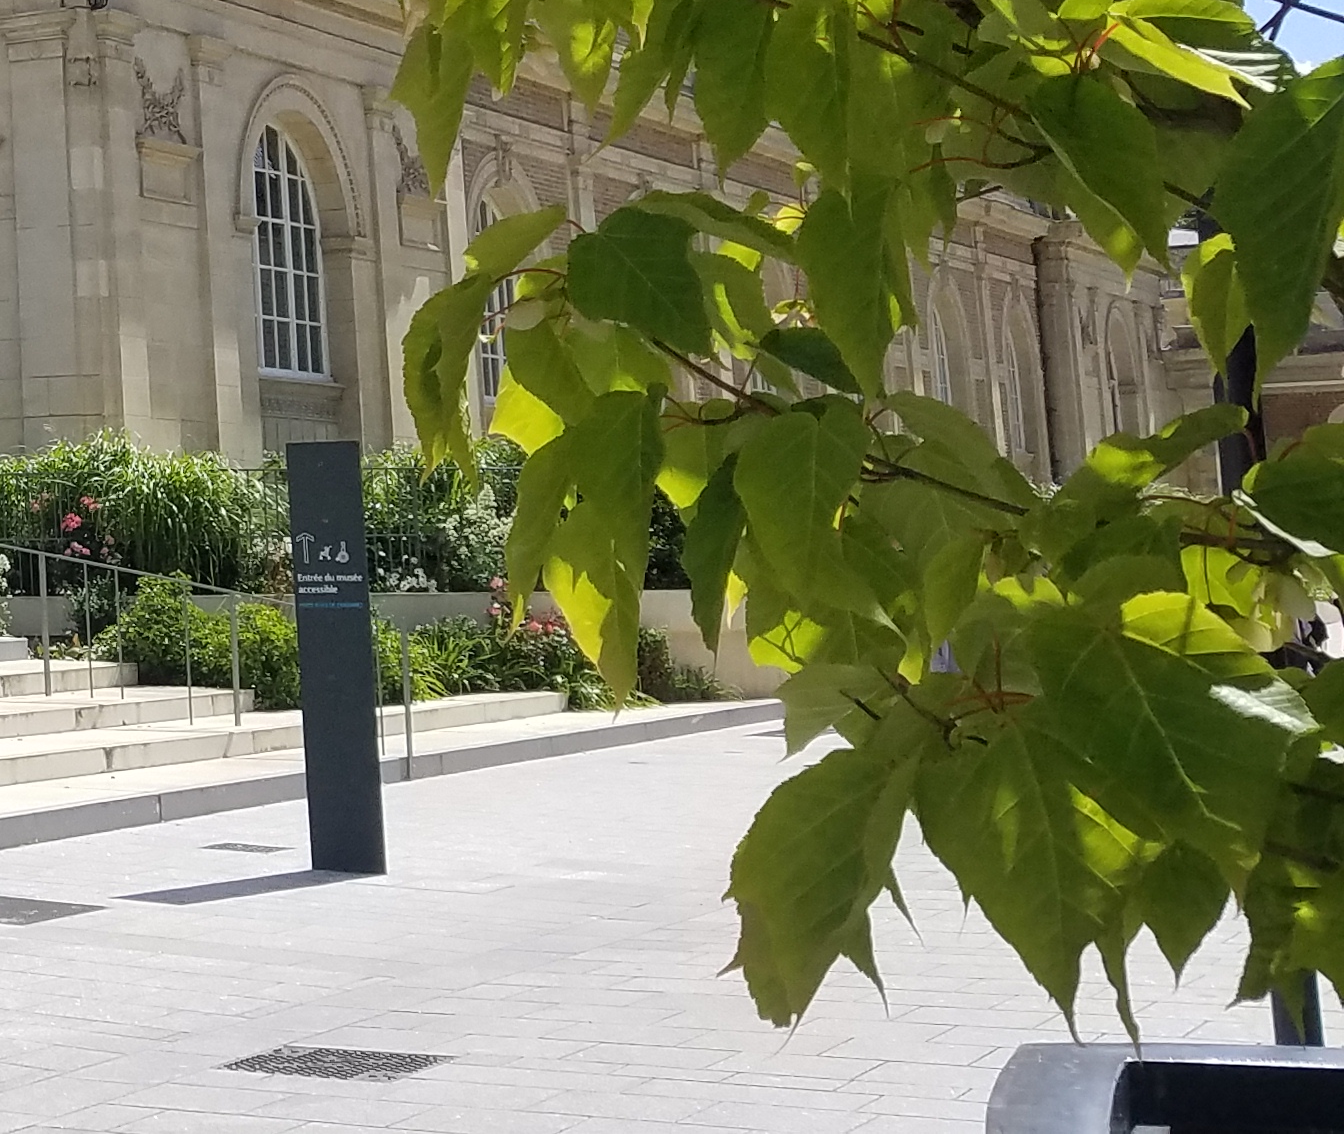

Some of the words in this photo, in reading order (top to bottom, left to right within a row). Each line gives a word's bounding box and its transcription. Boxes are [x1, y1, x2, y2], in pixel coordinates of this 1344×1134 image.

[297, 573, 323, 582] Entrée
[324, 572, 335, 582] du
[336, 573, 363, 582] musée
[298, 584, 338, 594] accessible
